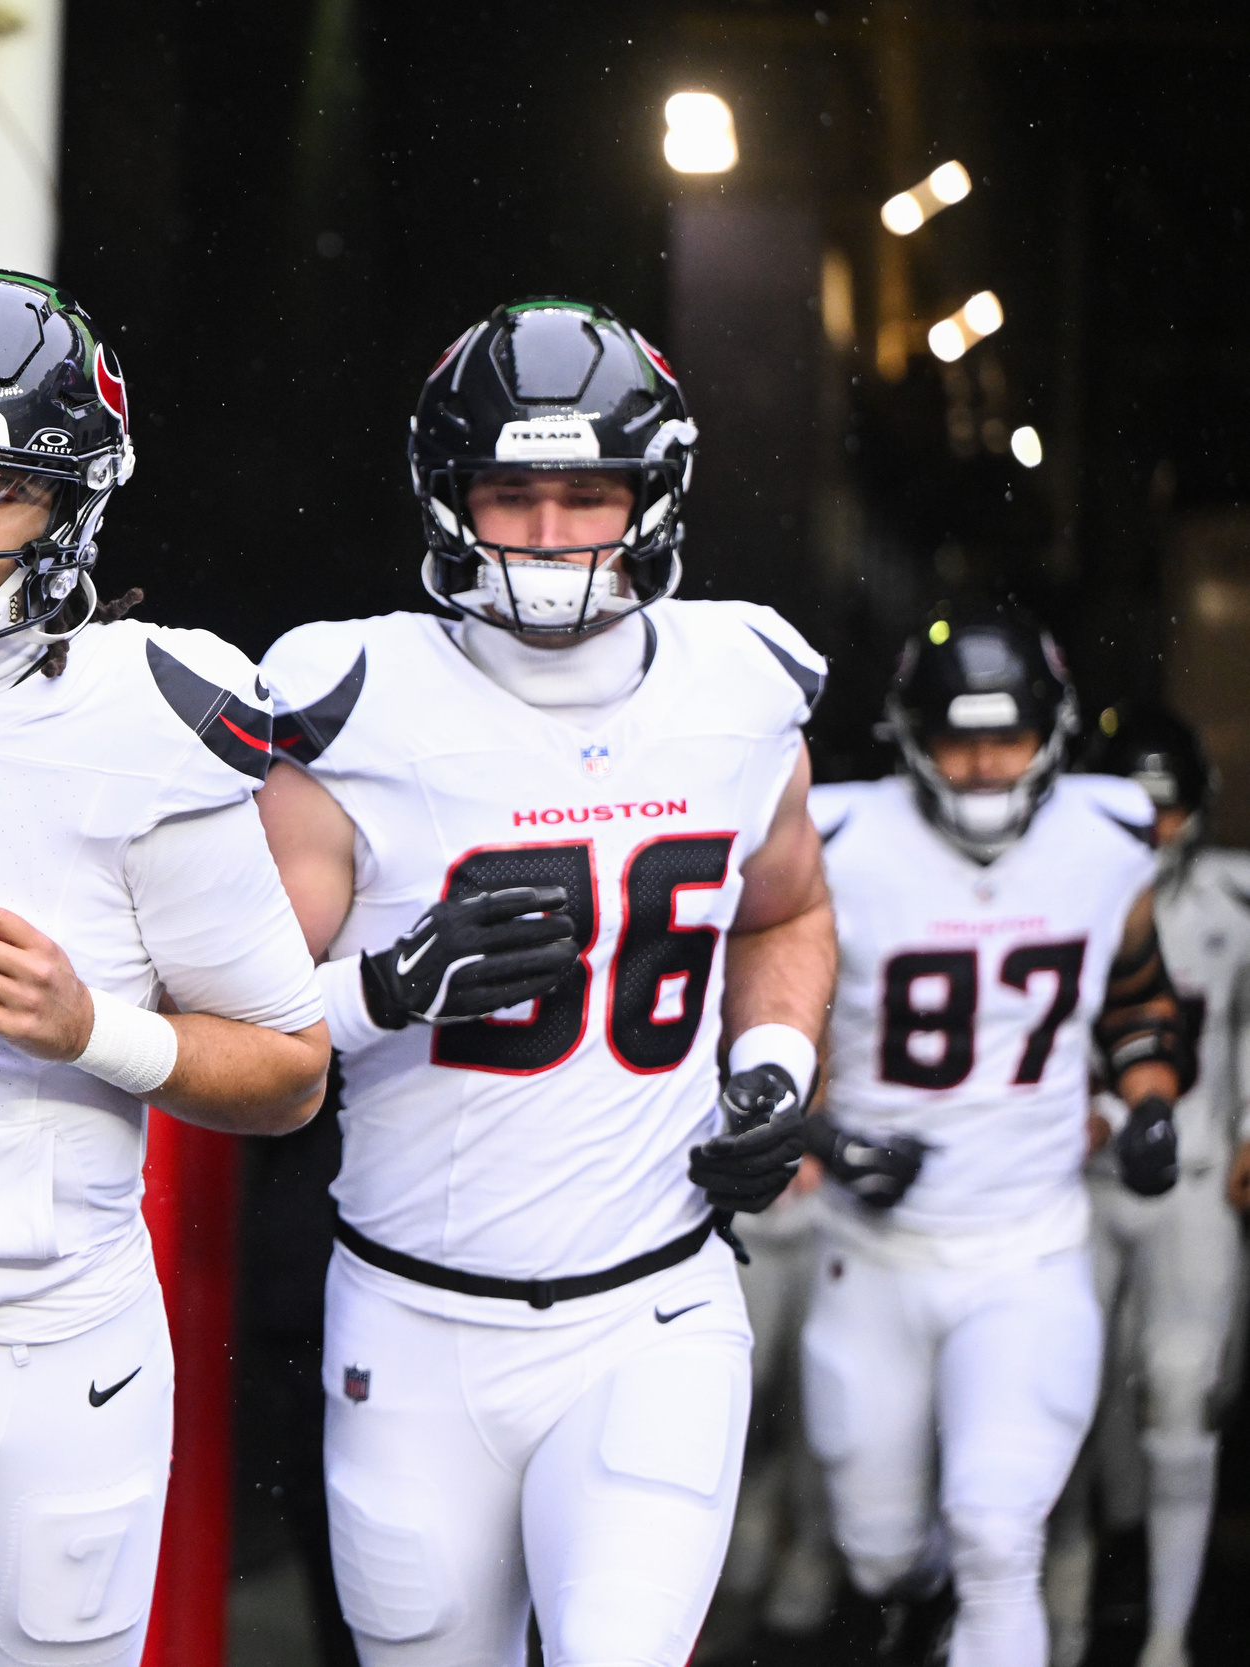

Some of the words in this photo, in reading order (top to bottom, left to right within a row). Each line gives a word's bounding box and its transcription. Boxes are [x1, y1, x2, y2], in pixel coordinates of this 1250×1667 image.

[511, 432, 582, 440] TEXANS
[31, 443, 73, 455] OAKLEY
[512, 798, 688, 827] HOUSTON
[880, 934, 1088, 1091] 87
